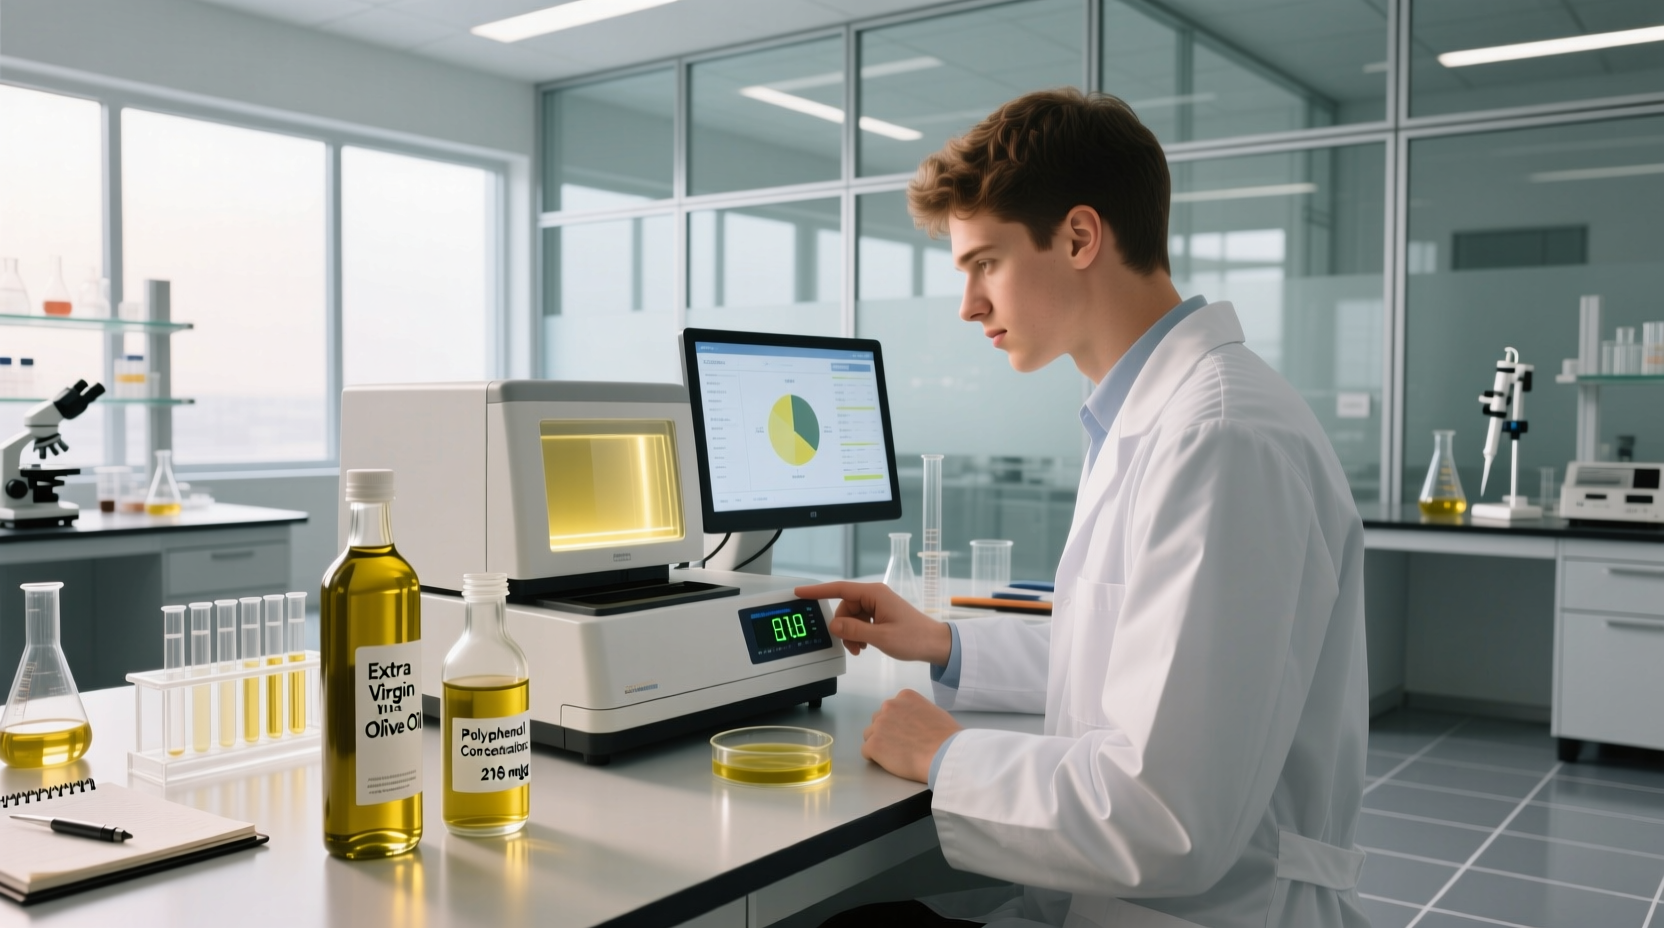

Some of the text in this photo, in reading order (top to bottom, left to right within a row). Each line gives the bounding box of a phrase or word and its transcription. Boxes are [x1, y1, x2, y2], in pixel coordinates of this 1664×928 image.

[369, 662, 411, 680] Extra
[369, 682, 415, 704] Virgin
[365, 711, 422, 739] Olive Oil
